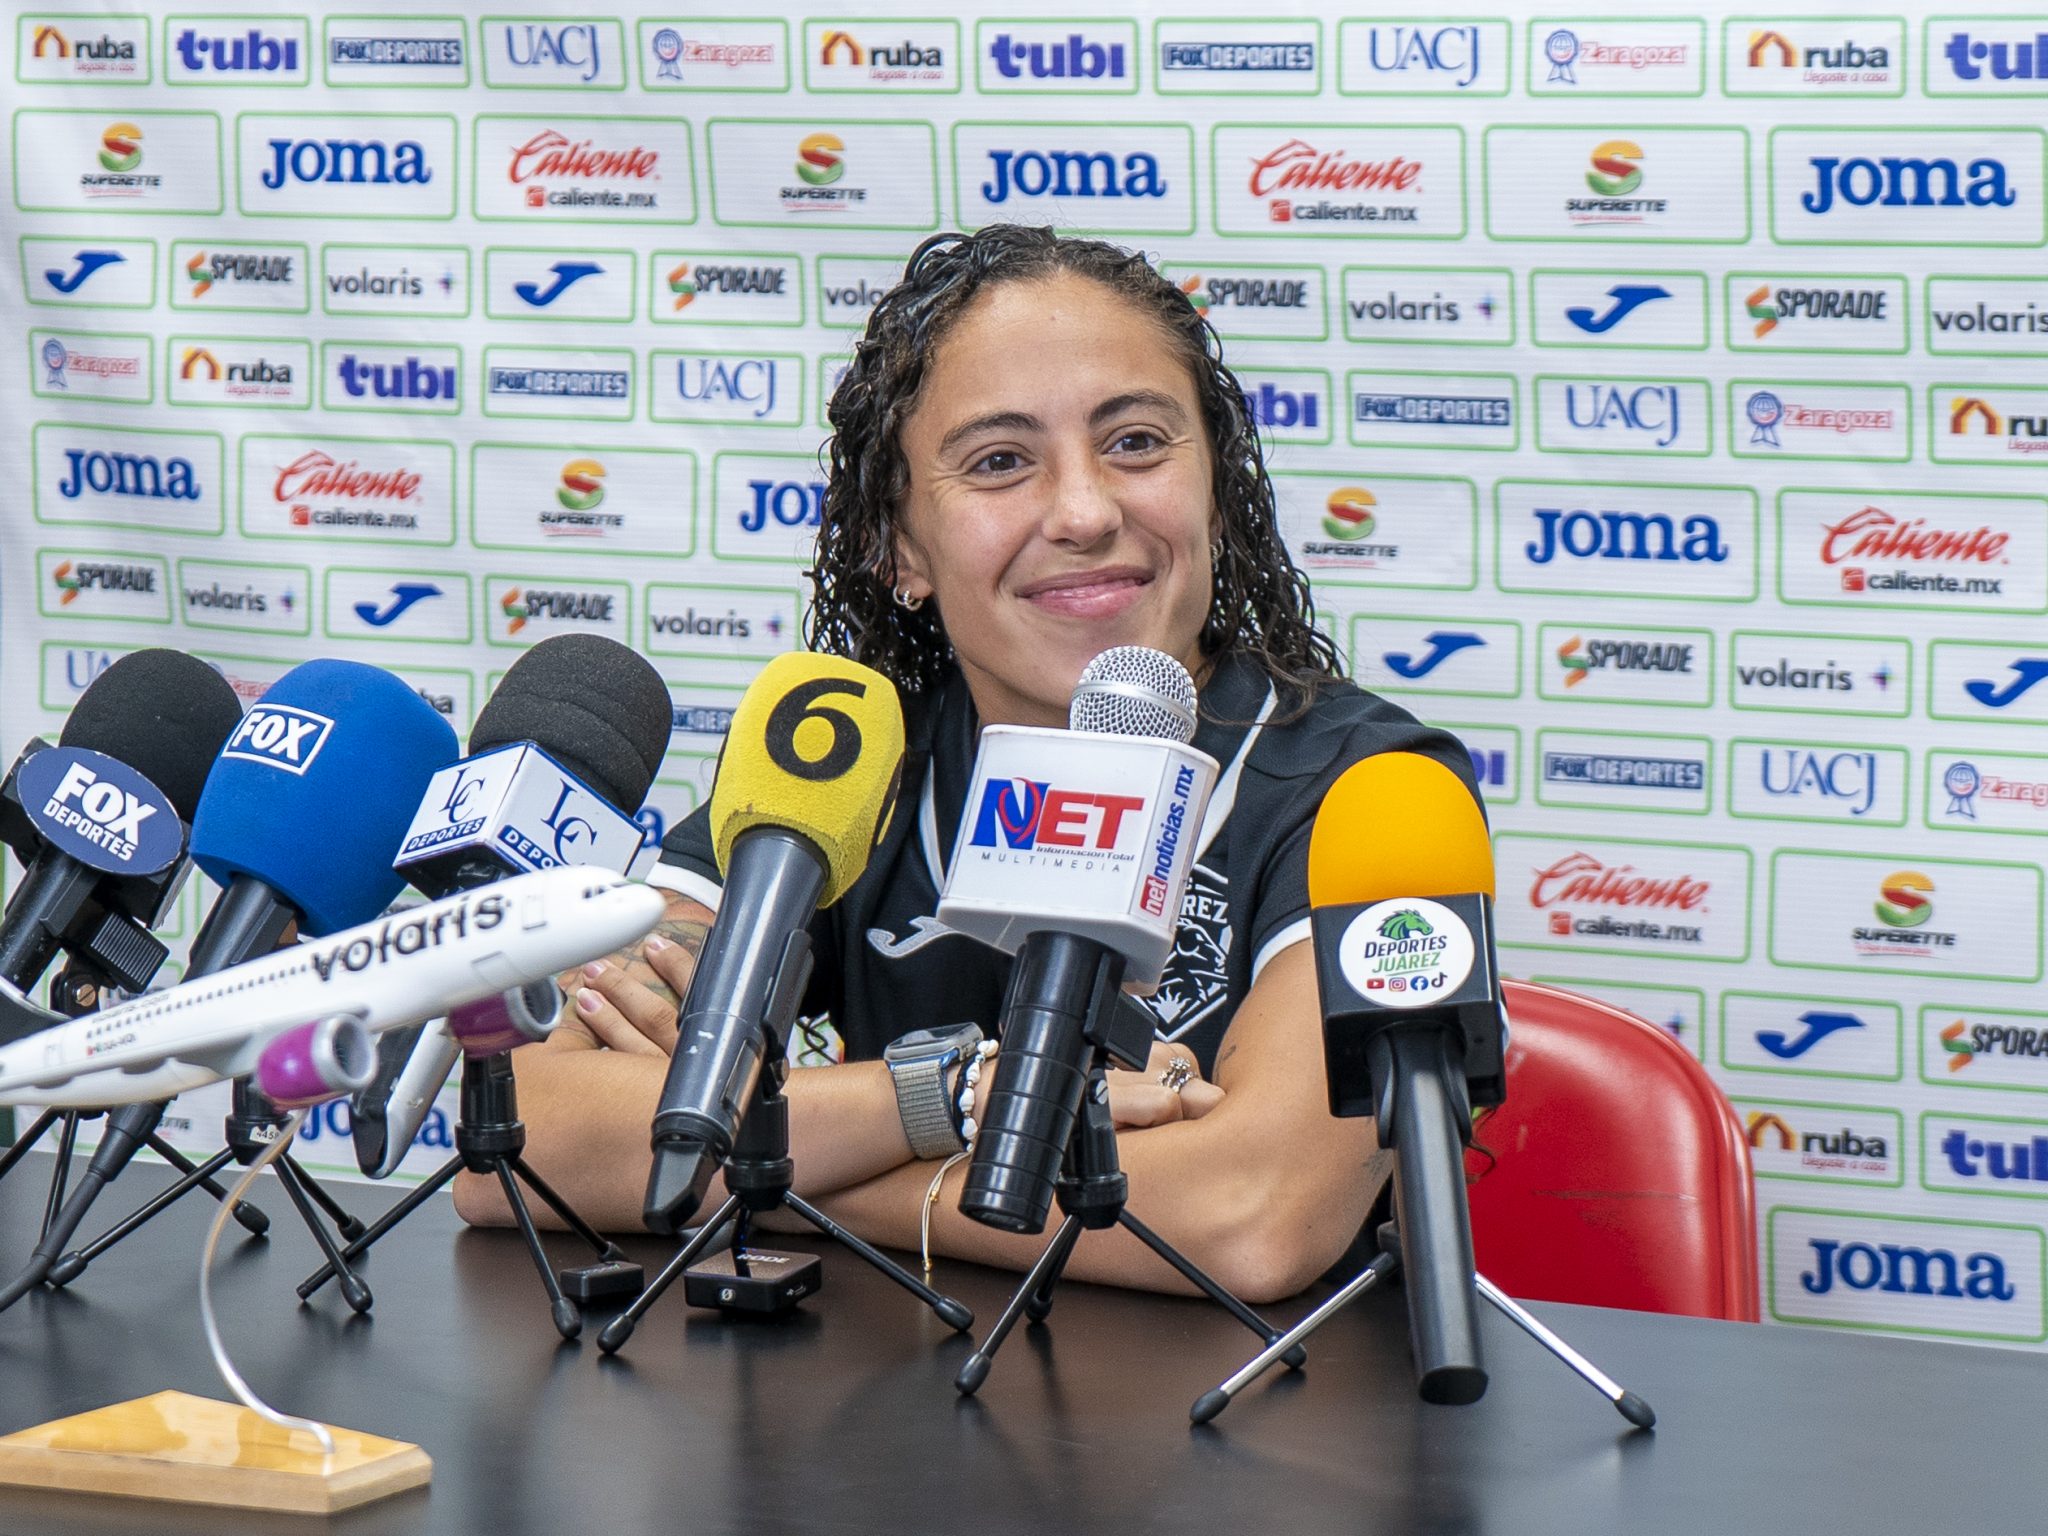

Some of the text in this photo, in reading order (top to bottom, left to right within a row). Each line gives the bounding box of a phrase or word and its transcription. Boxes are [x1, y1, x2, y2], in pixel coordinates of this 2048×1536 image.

[75, 36, 135, 60] ruba
[177, 29, 298, 71] tubi
[371, 39, 462, 64] DEPORTES
[506, 26, 600, 81] UACJ
[870, 40, 942, 67] ruba
[991, 34, 1124, 78] tubi
[1208, 44, 1312, 69] DEPORTES
[1370, 27, 1479, 87] UACJ
[1579, 41, 1687, 69] Zaragoza
[1803, 42, 1889, 68] ruba
[510, 130, 658, 183] Caliente
[1250, 140, 1422, 191] Caliente
[549, 189, 656, 208] caliente.mx
[779, 188, 866, 202] SUPERETTE
[1565, 200, 1666, 212] SUPERETTE
[1294, 202, 1417, 222] caliente.mx
[210, 254, 293, 283] SPORADE
[329, 267, 423, 296] volaris
[694, 266, 785, 295] SPORADE
[825, 280, 884, 305] vola
[1206, 280, 1307, 308] SPORADE
[1349, 293, 1459, 321] volaris
[1775, 289, 1886, 321] SPORADE
[1932, 302, 2048, 332] volaris
[227, 360, 292, 383] ruba
[339, 355, 456, 399] tubi
[532, 372, 627, 396] DEPORTES
[677, 359, 776, 416] UACJ
[1402, 398, 1509, 425] DEPORTES
[1566, 385, 1678, 446] UACJ
[1784, 404, 1892, 433] Zaragoza
[273, 449, 422, 501] Caliente
[314, 508, 417, 529] caliente.mx
[1303, 542, 1398, 557] SUPERETTE
[1820, 506, 2010, 564] Caliente
[184, 583, 266, 611] volaris
[1867, 572, 2001, 594] caliente.mx
[526, 590, 614, 622] SPORADE
[651, 609, 750, 637] volaris
[1587, 640, 1693, 672] SPORADE
[1737, 658, 1852, 691] volaris
[232, 711, 318, 761] FOX
[765, 678, 867, 782] 6
[1593, 757, 1703, 788] DEPORTES
[1762, 751, 1875, 814] UACJ
[52, 761, 157, 846] FOX
[970, 777, 1145, 851] NET
[42, 798, 138, 861] DEPORTES
[407, 819, 483, 850] DEPORTES
[1142, 763, 1195, 916] netnoticias.mx
[504, 826, 555, 869] DEPO
[1107, 851, 1135, 861] Total
[981, 852, 1121, 873] MULTIMEDIA
[1531, 852, 1710, 911] Caliente
[1181, 895, 1228, 924] REZ
[310, 892, 506, 982] volaris
[1576, 919, 1701, 942] caliente.mx
[1852, 928, 1956, 945] SUPERETTE
[1364, 935, 1447, 959] DEPORTES
[1802, 1128, 1887, 1158] ruba
